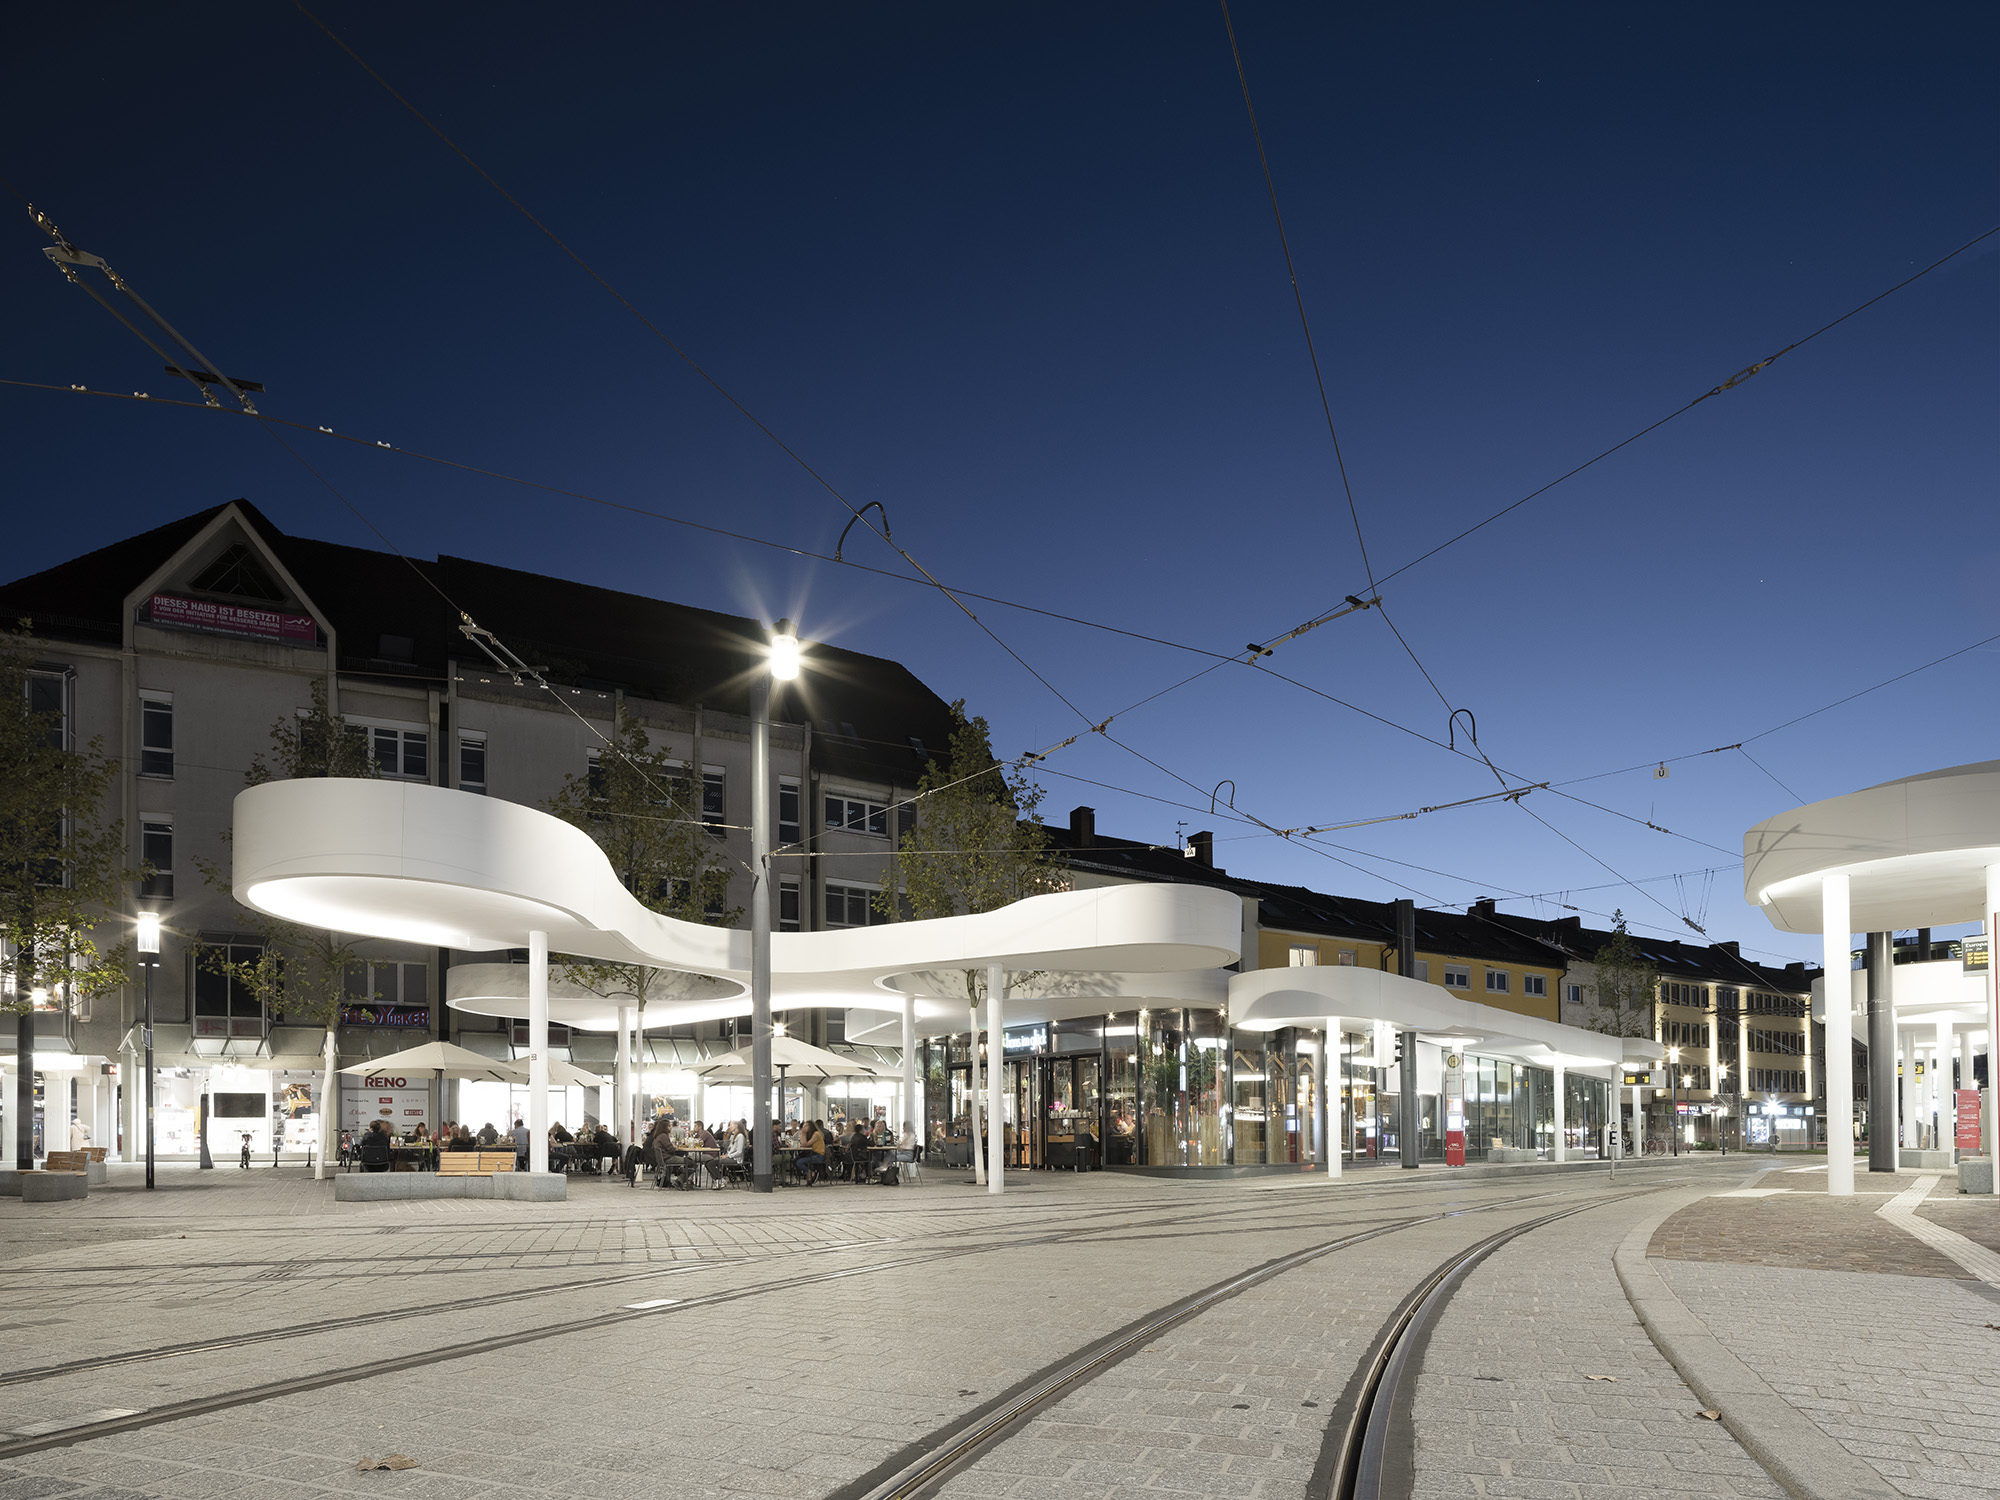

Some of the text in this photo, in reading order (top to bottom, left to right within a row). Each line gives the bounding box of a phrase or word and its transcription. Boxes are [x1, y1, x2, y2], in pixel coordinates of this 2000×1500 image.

[154, 596, 280, 623] DIESES HAUS IST BESETZT!
[186, 610, 215, 618] INITIATIVE
[229, 616, 258, 625] BESSERES
[364, 1077, 407, 1088] RENO
[1609, 1130, 1618, 1146] E
